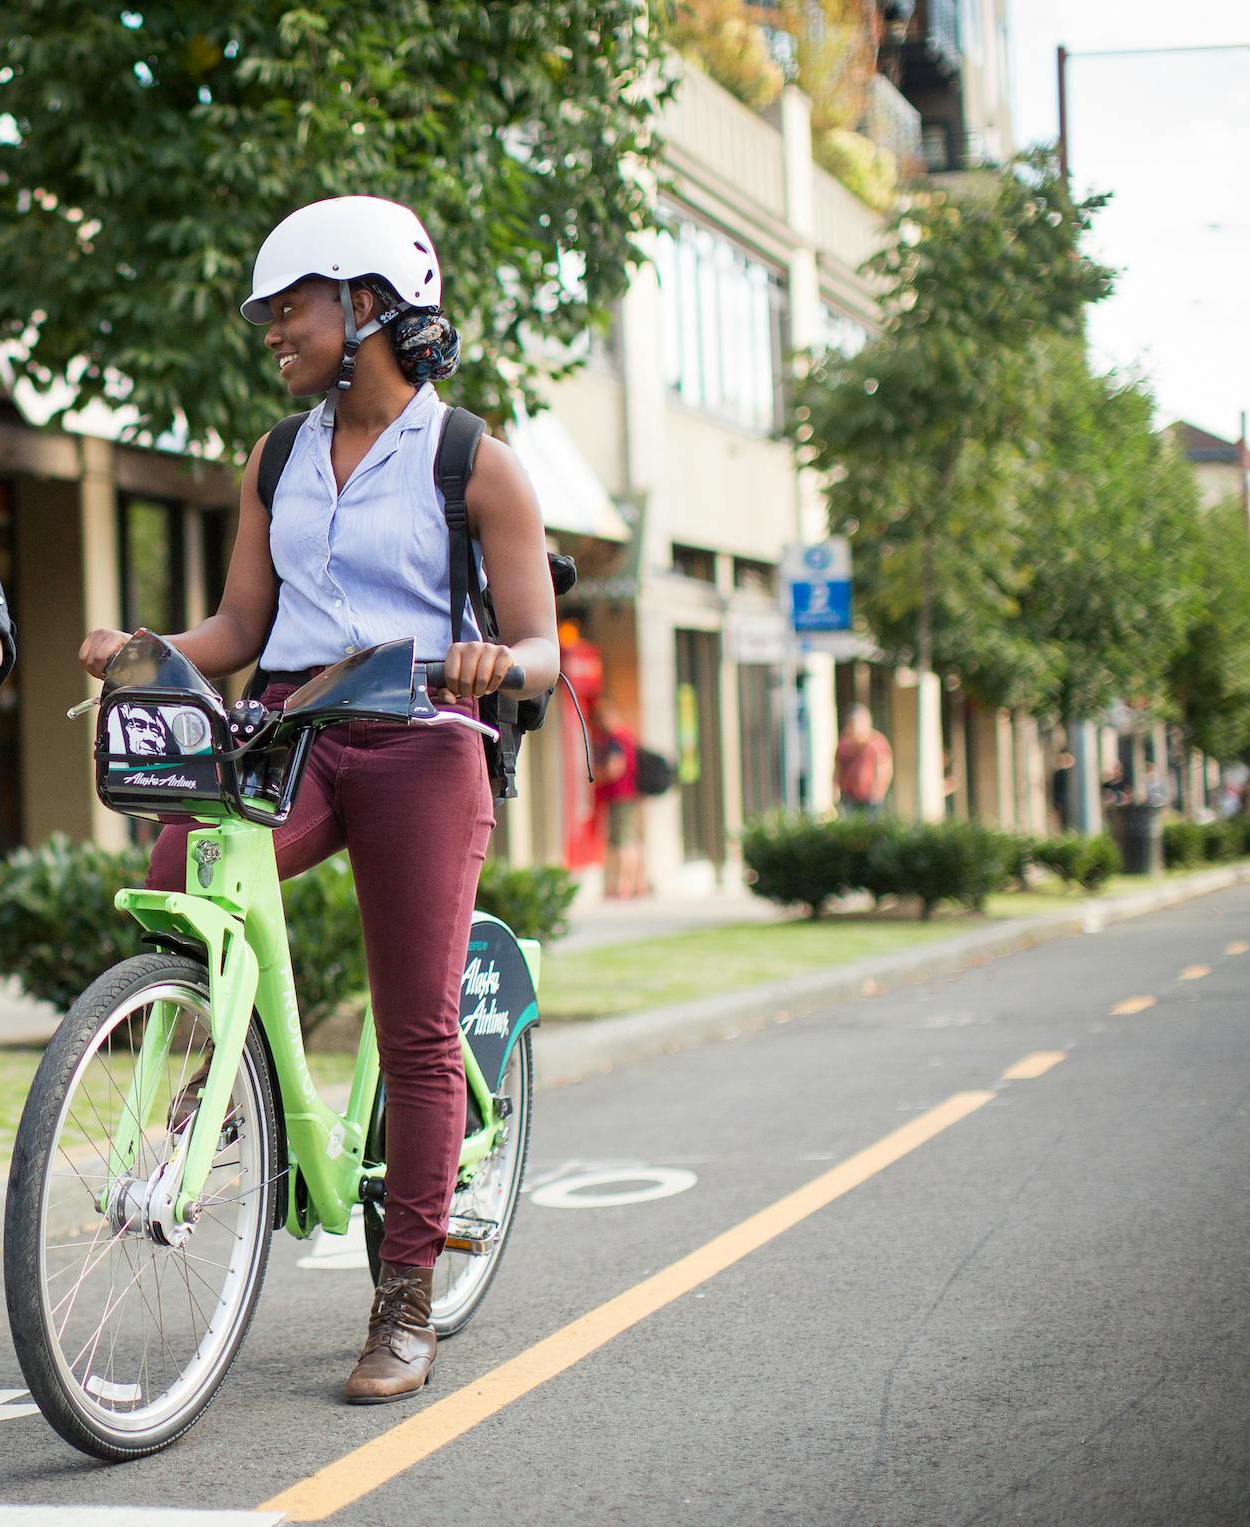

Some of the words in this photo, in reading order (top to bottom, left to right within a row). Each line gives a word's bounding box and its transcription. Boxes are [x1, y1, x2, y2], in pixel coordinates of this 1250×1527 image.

[123, 772, 159, 786] Alaska
[159, 774, 197, 789] Airlines
[461, 957, 500, 1000] Alaska
[461, 997, 509, 1038] Airlines
